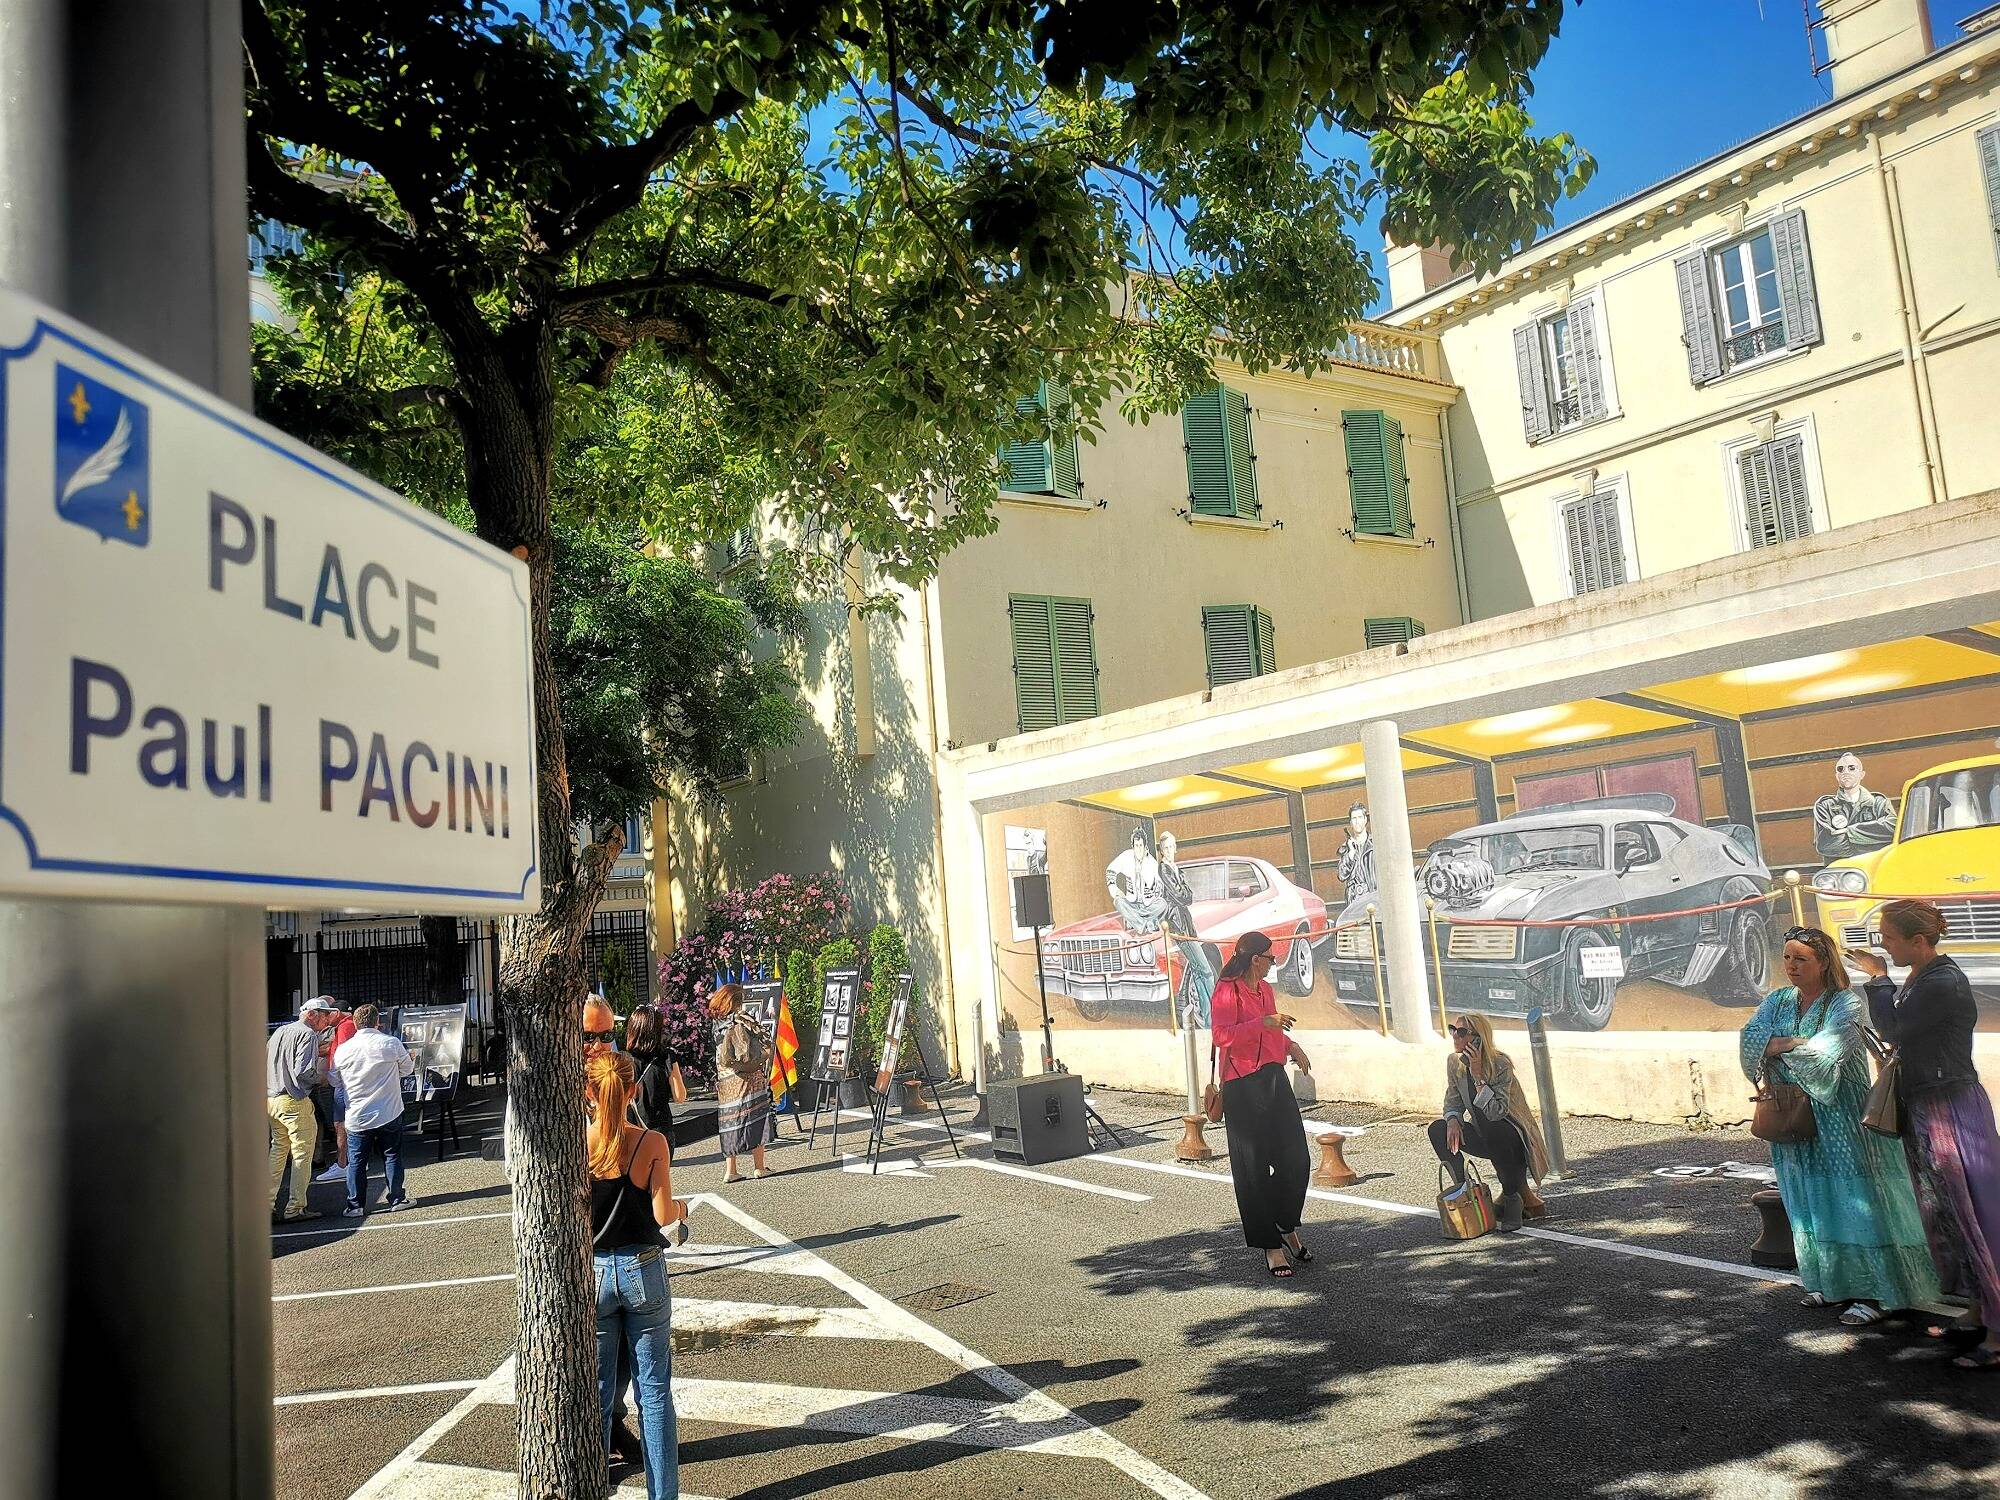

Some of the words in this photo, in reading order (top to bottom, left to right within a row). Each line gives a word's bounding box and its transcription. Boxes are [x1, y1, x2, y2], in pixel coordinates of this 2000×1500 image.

[208, 490, 440, 670] PLACE
[69, 655, 272, 803] Paul
[318, 717, 511, 841] PACINI
